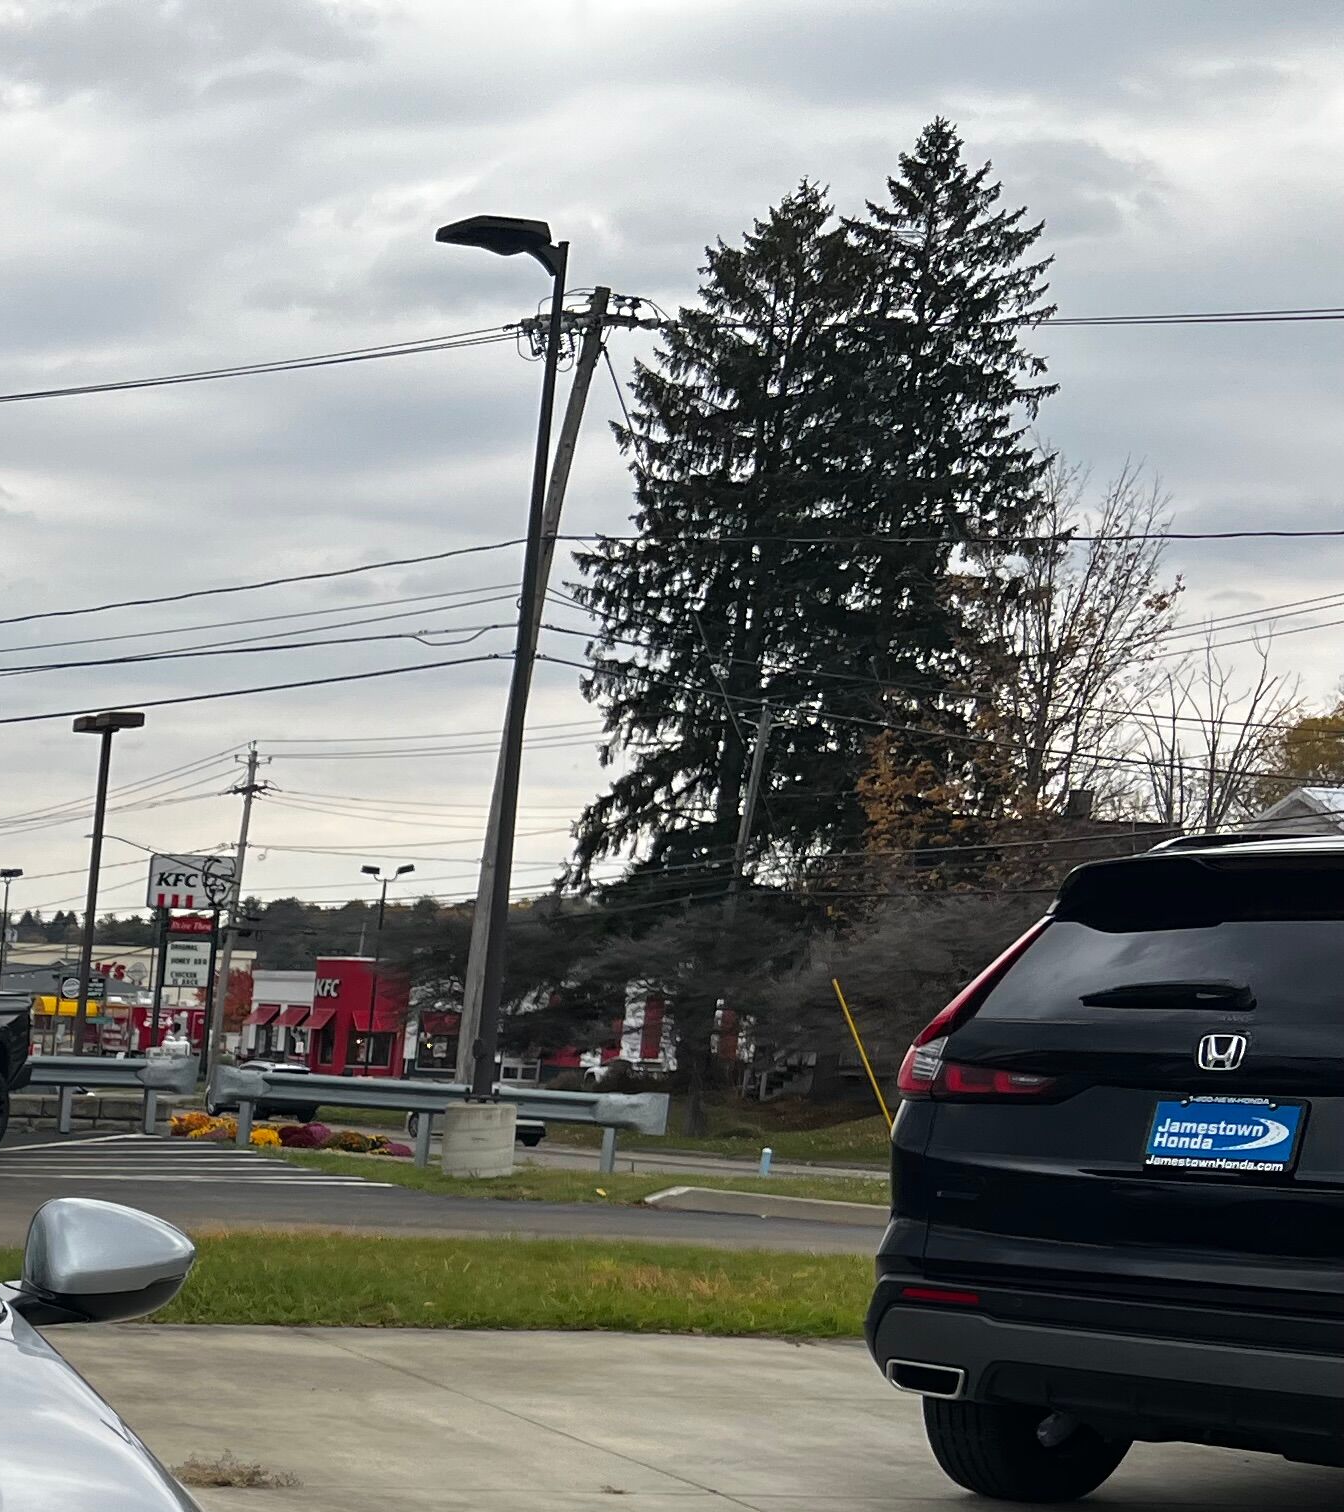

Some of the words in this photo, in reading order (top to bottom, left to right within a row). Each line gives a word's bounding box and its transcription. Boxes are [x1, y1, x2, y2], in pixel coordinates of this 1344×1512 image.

[156, 872, 198, 887] KFC
[315, 979, 339, 997] KFC
[1157, 1118, 1264, 1138] Jamestown
[1153, 1133, 1214, 1151] Honda
[1146, 1155, 1283, 1171] JamestownHonda.com
